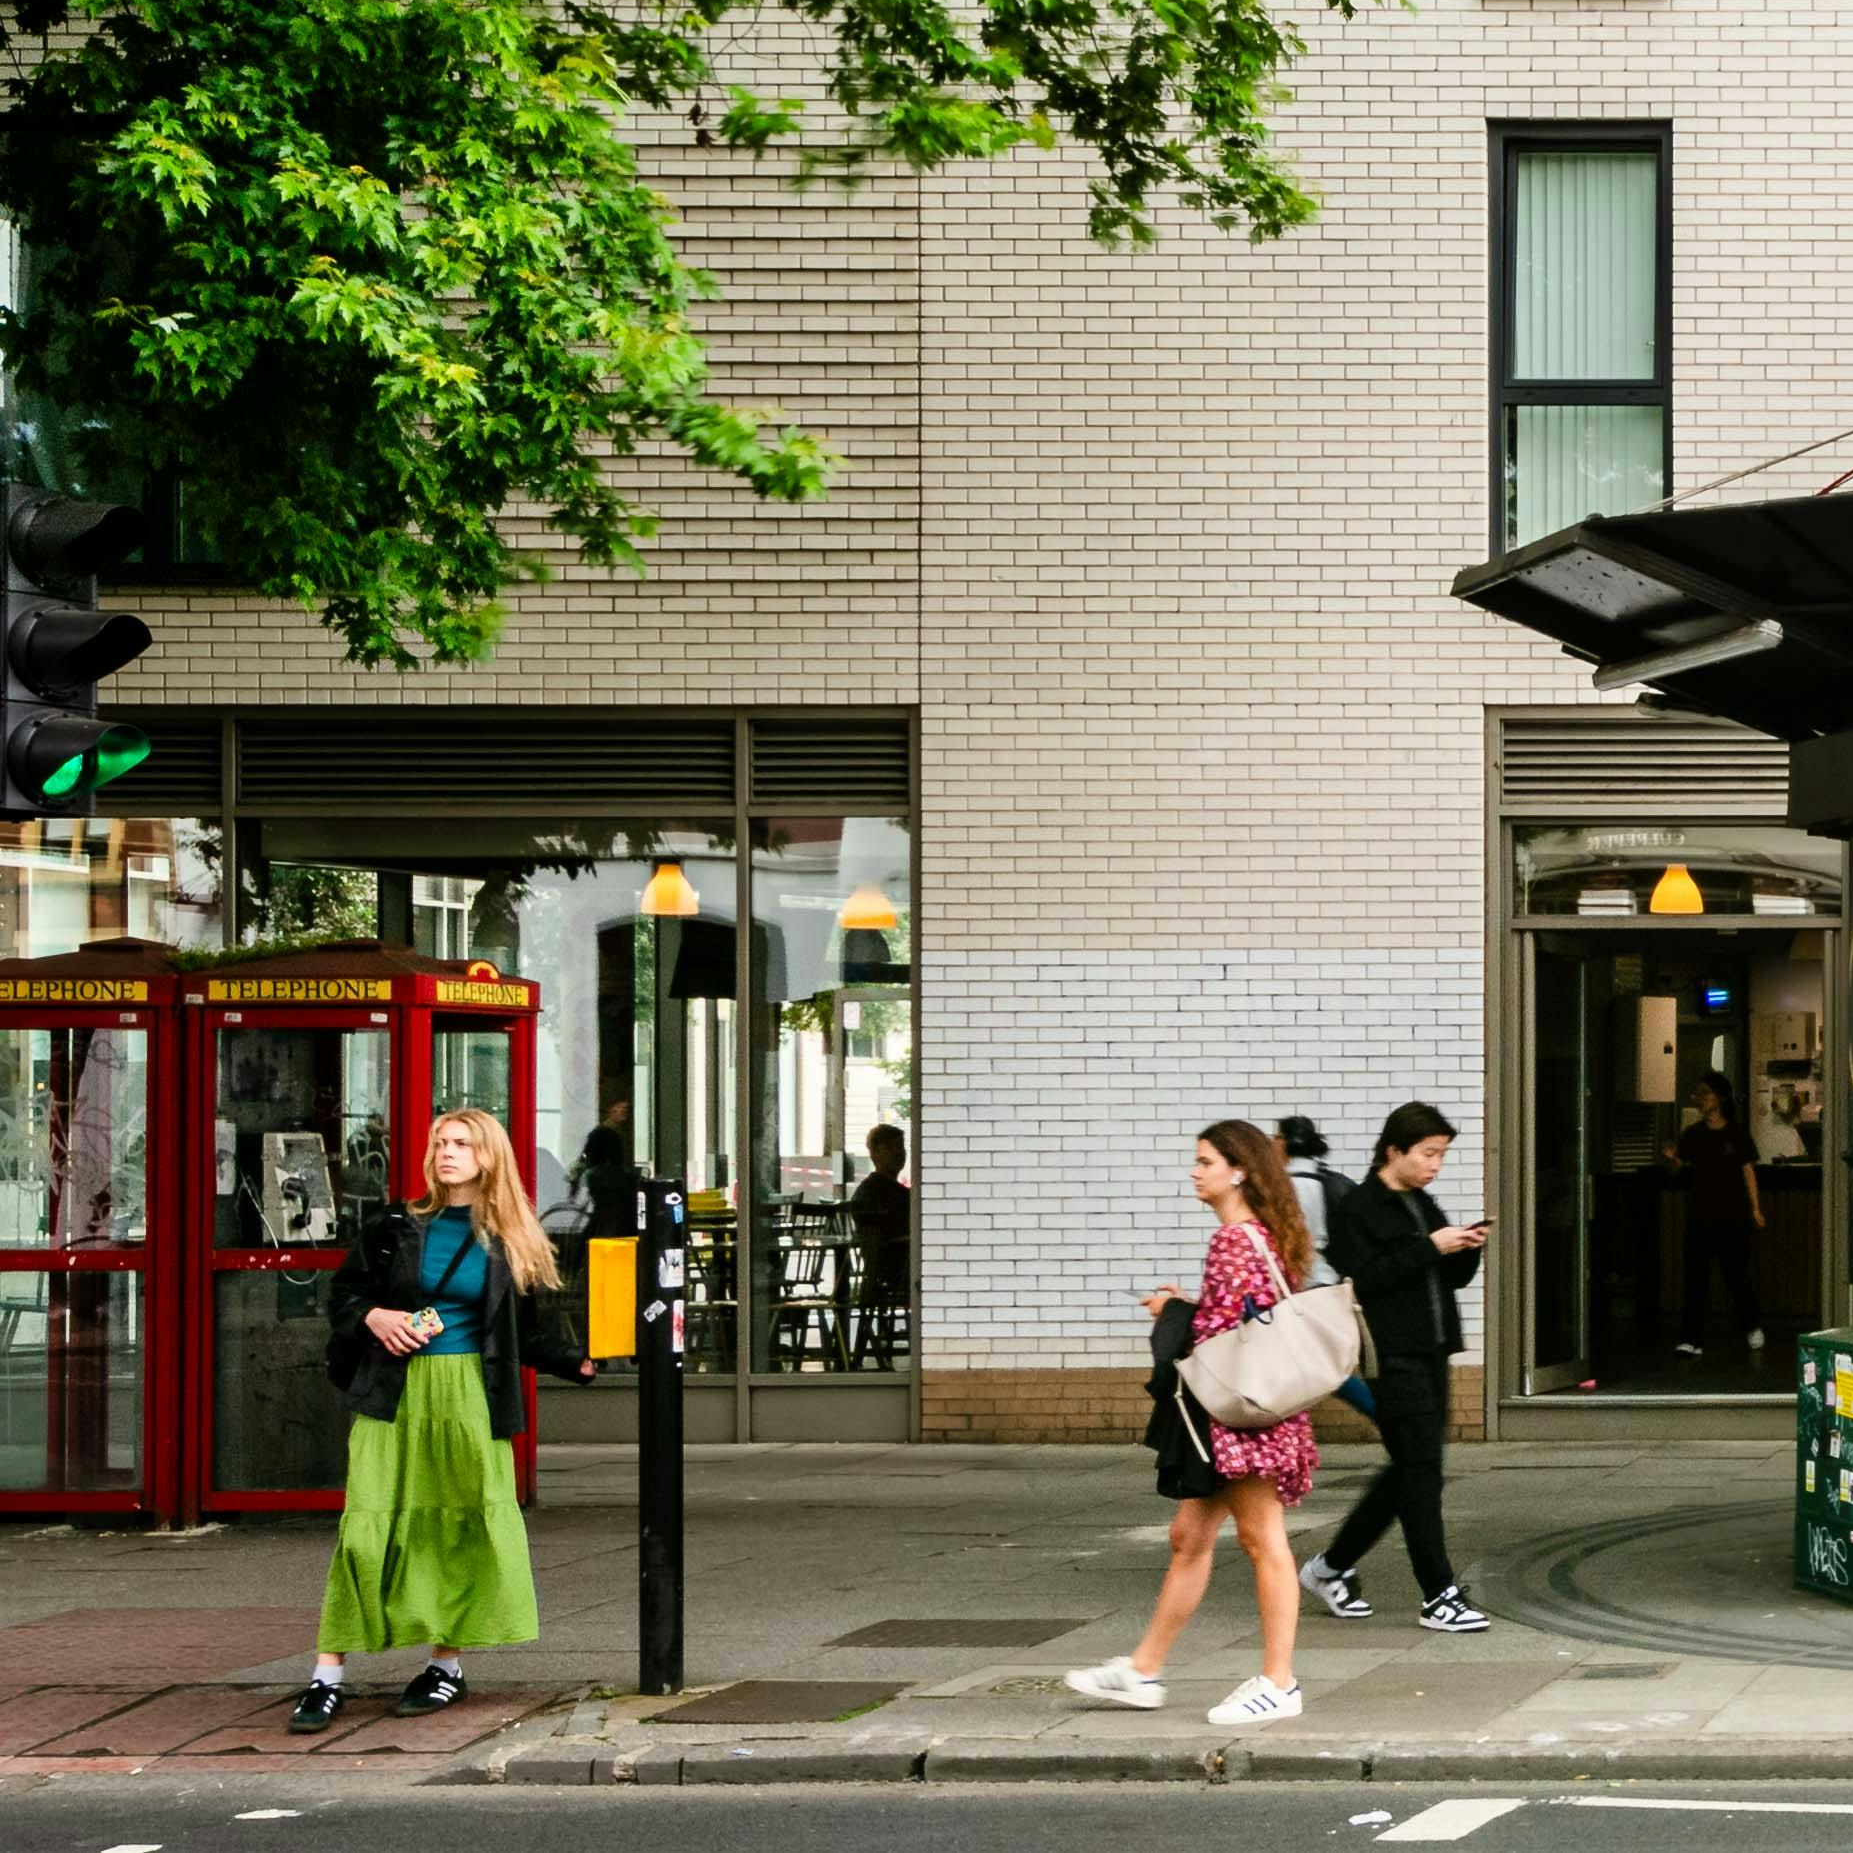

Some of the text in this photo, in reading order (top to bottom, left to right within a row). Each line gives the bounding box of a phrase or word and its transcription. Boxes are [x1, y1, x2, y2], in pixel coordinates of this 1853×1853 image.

[0, 981, 135, 1001] ELEPHONE
[218, 979, 380, 1000] TELEPHONE
[442, 981, 524, 1006] TELEPHONE
